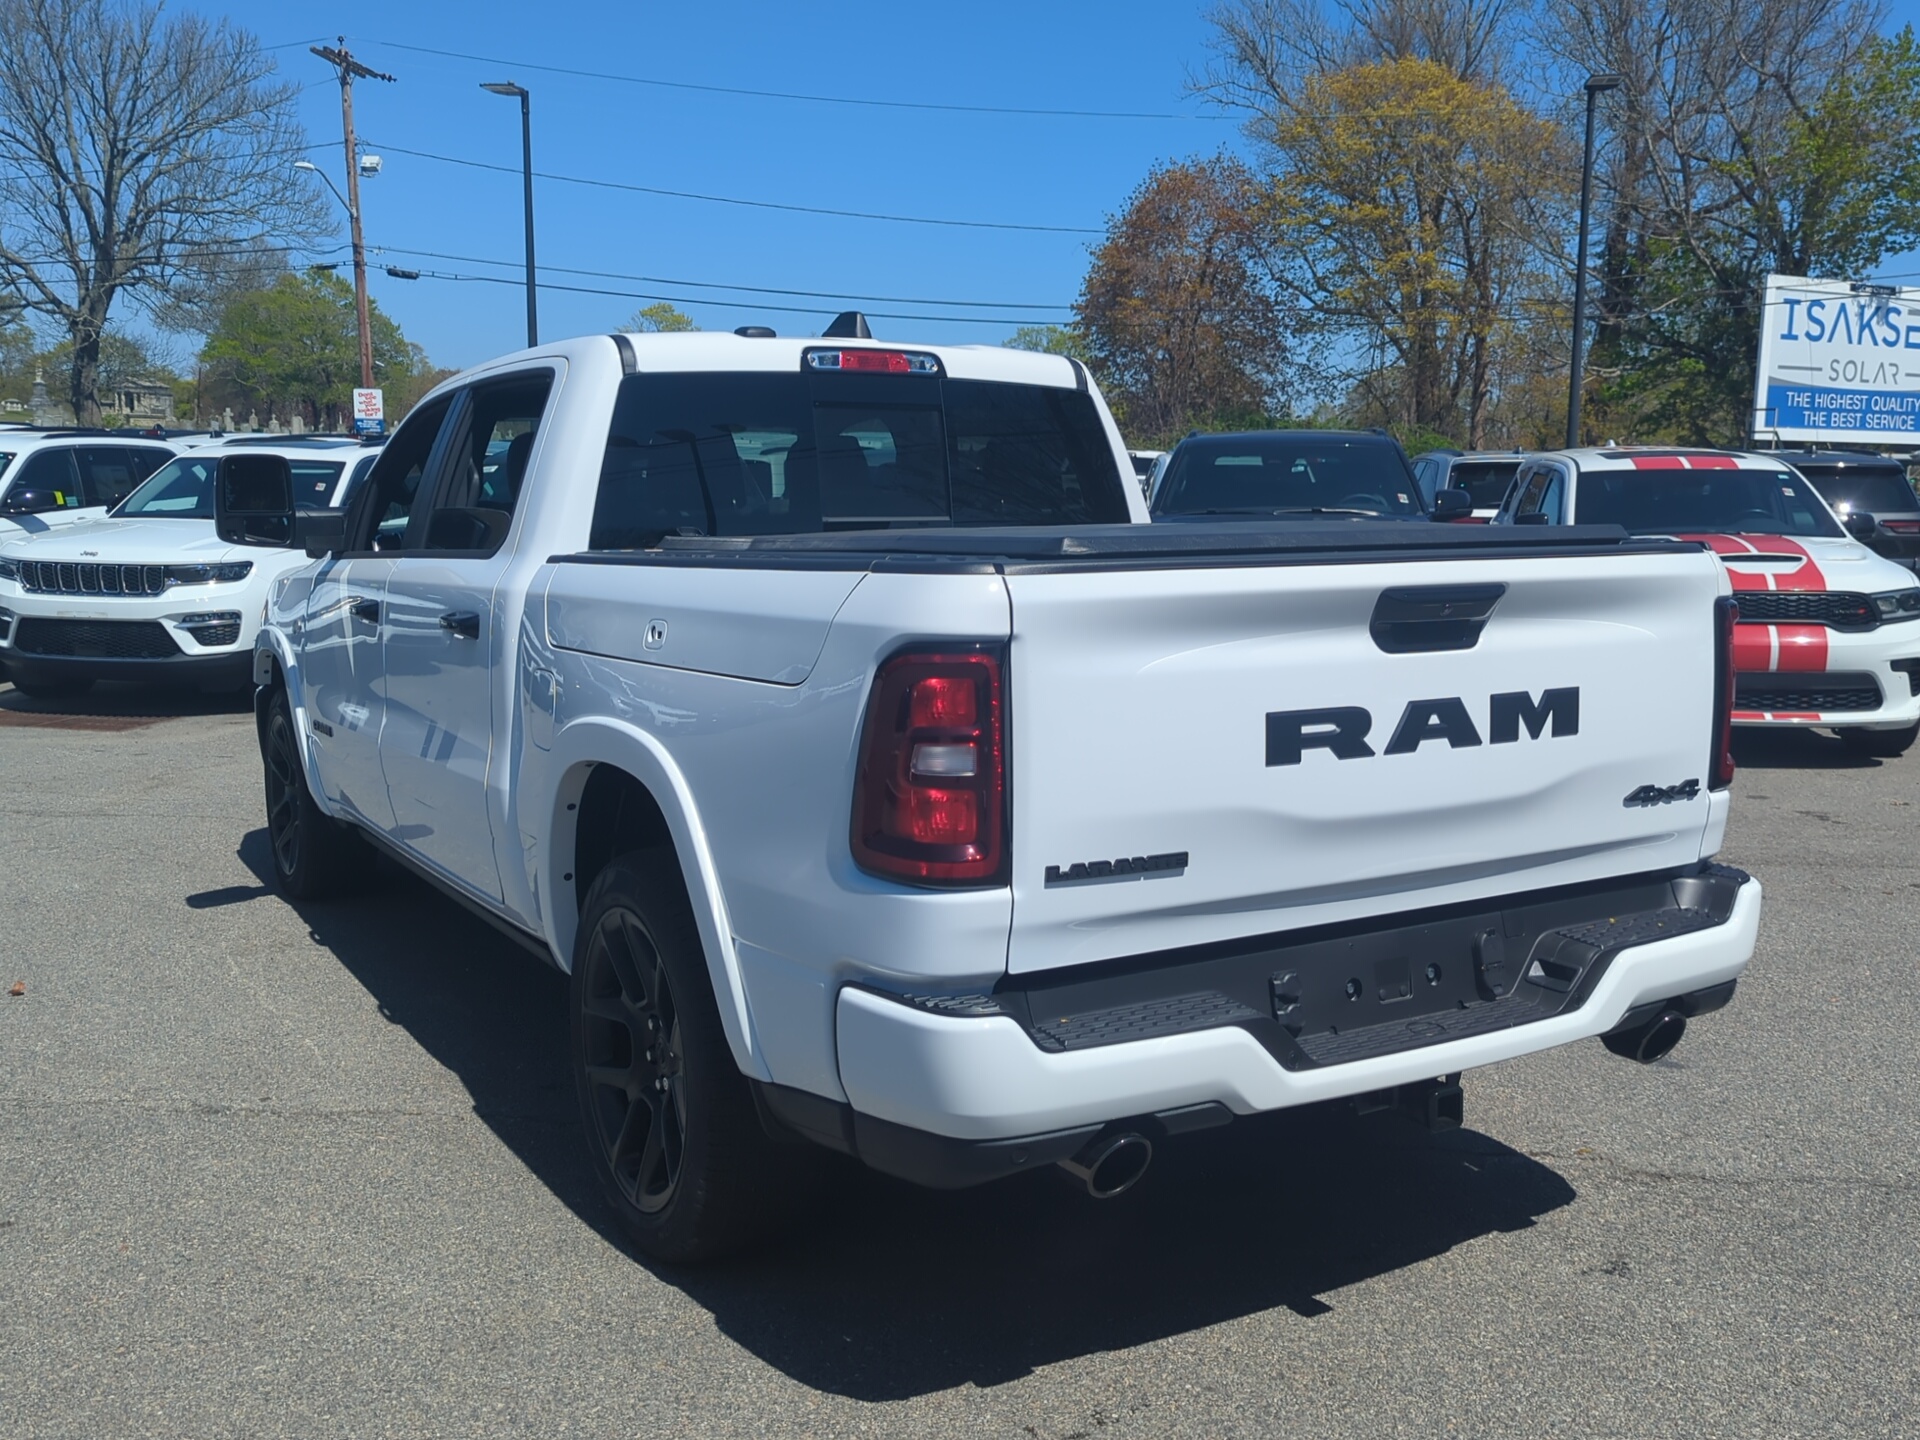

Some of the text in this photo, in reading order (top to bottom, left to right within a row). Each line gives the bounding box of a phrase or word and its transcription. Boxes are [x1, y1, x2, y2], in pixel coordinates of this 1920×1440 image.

[1828, 358, 1900, 385] SOLAR
[1786, 391, 1920, 412] THE HIGHEST QUALITY
[1803, 411, 1915, 430] THE BEST SERVICE
[1265, 686, 1580, 768] RAM
